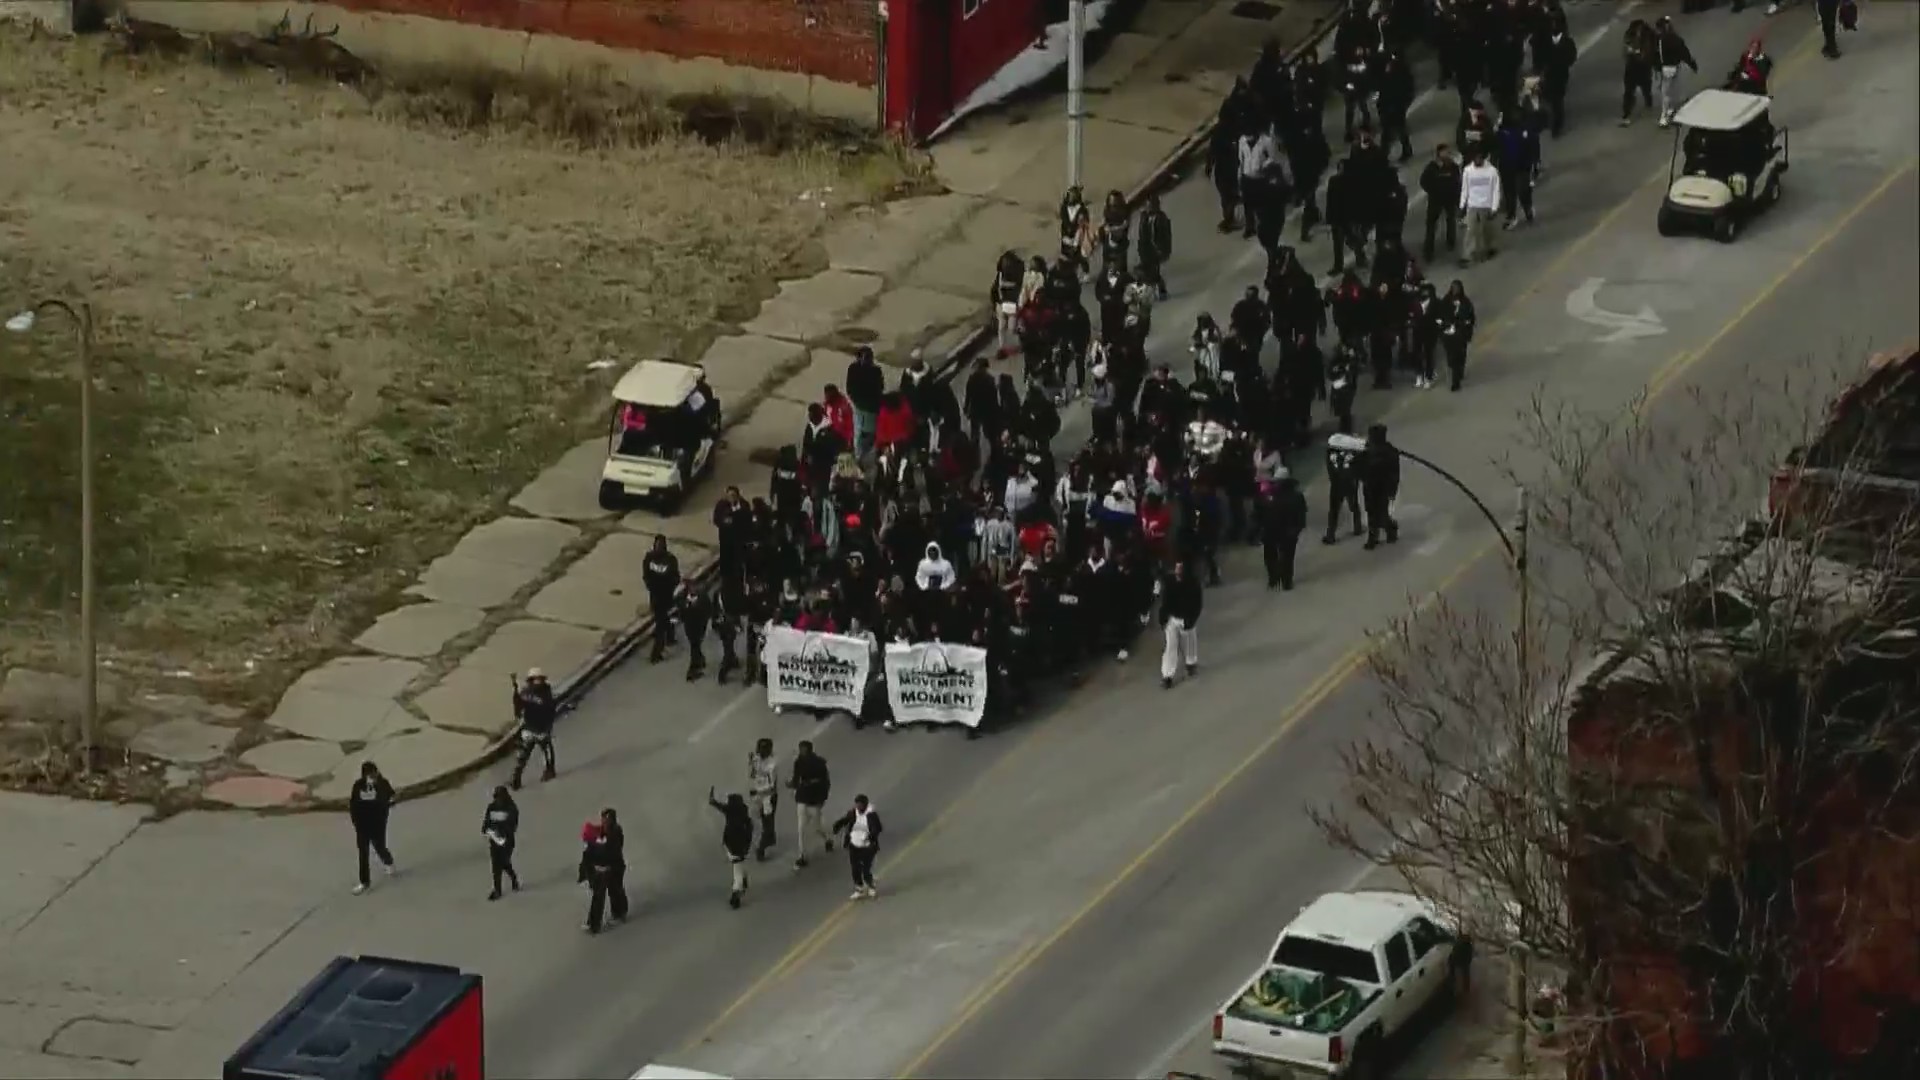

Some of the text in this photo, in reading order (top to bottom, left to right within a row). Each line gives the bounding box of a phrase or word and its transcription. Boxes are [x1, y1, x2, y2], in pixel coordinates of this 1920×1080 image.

[780, 675, 854, 693] MOMENT
[898, 673, 974, 688] MOVEMENT
[901, 691, 973, 706] MOMENT
